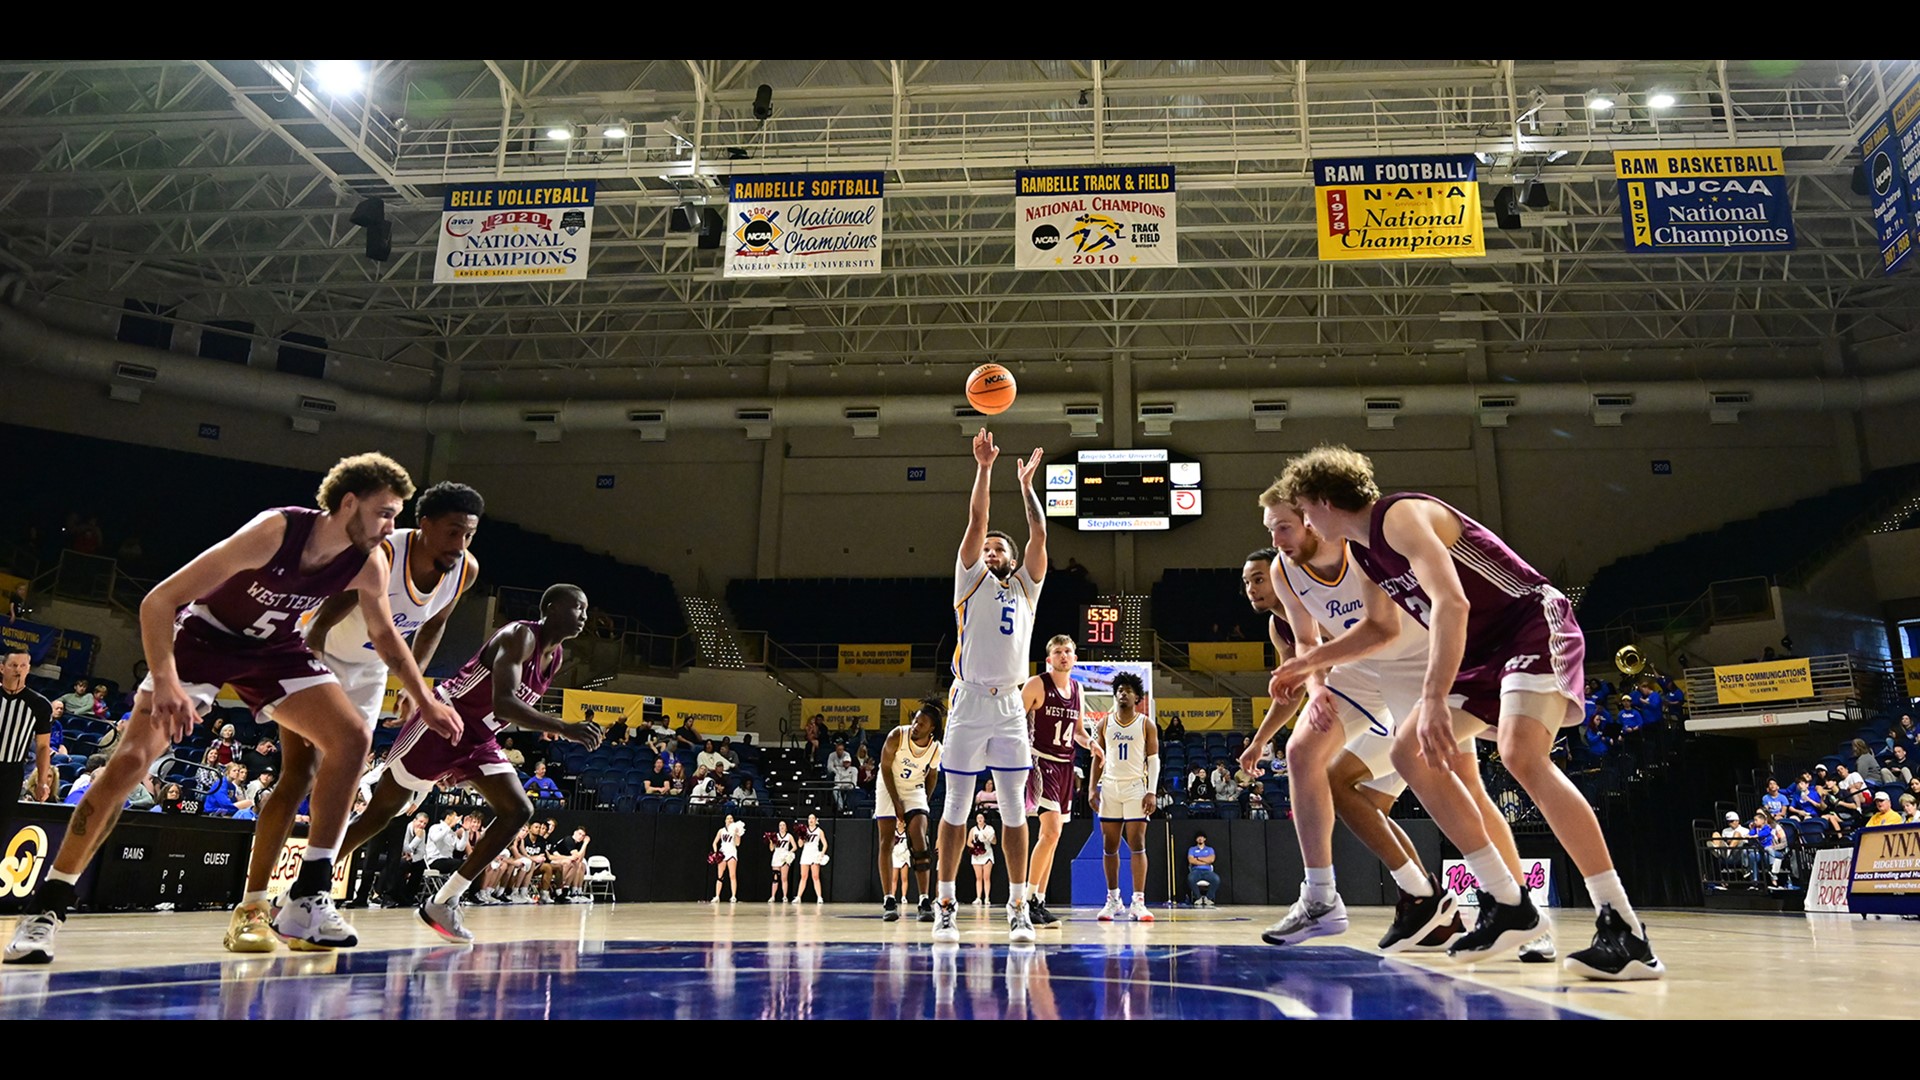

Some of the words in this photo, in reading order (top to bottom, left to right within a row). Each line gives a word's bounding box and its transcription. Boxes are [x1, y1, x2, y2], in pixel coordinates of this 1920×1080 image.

[1324, 165, 1364, 182] RAM
[1375, 162, 1468, 181] FOOTBALL
[1622, 157, 1658, 175] RAM
[1668, 155, 1778, 174] BASKETBALL
[735, 181, 805, 199] RAMBELLE
[811, 179, 879, 196] SOFTBALL
[1021, 175, 1079, 193] RAMBELLE
[1083, 174, 1121, 191] TRACK
[1125, 174, 1135, 190] &
[1138, 173, 1169, 190] FIELD
[1655, 179, 1773, 198] NJCAA
[450, 190, 493, 207] BELLE
[497, 187, 589, 206] VOLLEYBALL
[494, 212, 541, 225] 2020
[747, 207, 772, 217] 2004
[787, 203, 876, 227] National
[1331, 193, 1347, 230] 1978
[1363, 204, 1466, 228] National
[1632, 186, 1646, 237] 1957
[1668, 202, 1767, 222] National
[450, 217, 474, 226] avca
[1132, 223, 1159, 233] TRACK
[465, 233, 565, 250] NATIONAL
[747, 232, 771, 241] NCAA
[784, 231, 877, 254] Champions
[1034, 236, 1060, 245] NCAA
[1131, 234, 1138, 243] &
[1139, 233, 1160, 243] FIELD
[1341, 228, 1473, 252] Champions
[1654, 226, 1789, 247] Champions
[731, 263, 770, 271] ANGELO
[777, 262, 807, 270] STATE
[814, 260, 876, 268] UNIVERSITY
[1072, 254, 1119, 265] 2010
[984, 374, 1007, 386] NCAA
[1128, 452, 1165, 460] University
[909, 470, 924, 478] 207
[1050, 469, 1074, 485] ASU
[1087, 519, 1132, 528] Stephens
[247, 581, 288, 607] WEST
[1088, 608, 1118, 622] 15:58
[1326, 599, 1364, 618] Ram
[243, 610, 290, 640] 5
[1000, 606, 1015, 636] 5
[1088, 621, 1114, 642] 30
[1718, 674, 1744, 684] FOSTER
[1745, 667, 1807, 681] COMMUNICATIONS
[580, 703, 604, 713] FRANKE
[605, 705, 625, 714] FAMILY
[1045, 706, 1064, 717] WEST
[1053, 720, 1074, 748] 14
[1112, 731, 1134, 741] Rams
[1118, 743, 1128, 760] 11
[900, 768, 912, 779] 3
[180, 801, 198, 811] POSS
[122, 847, 145, 860] RAMS
[204, 852, 230, 866] GUEST
[1873, 859, 1913, 869] RIDGEVIEW
[162, 870, 168, 880] P
[179, 870, 185, 880] P
[1854, 872, 1873, 880] Exotics
[1874, 872, 1899, 880] Breeding
[160, 884, 166, 895] B
[177, 884, 183, 895] B
